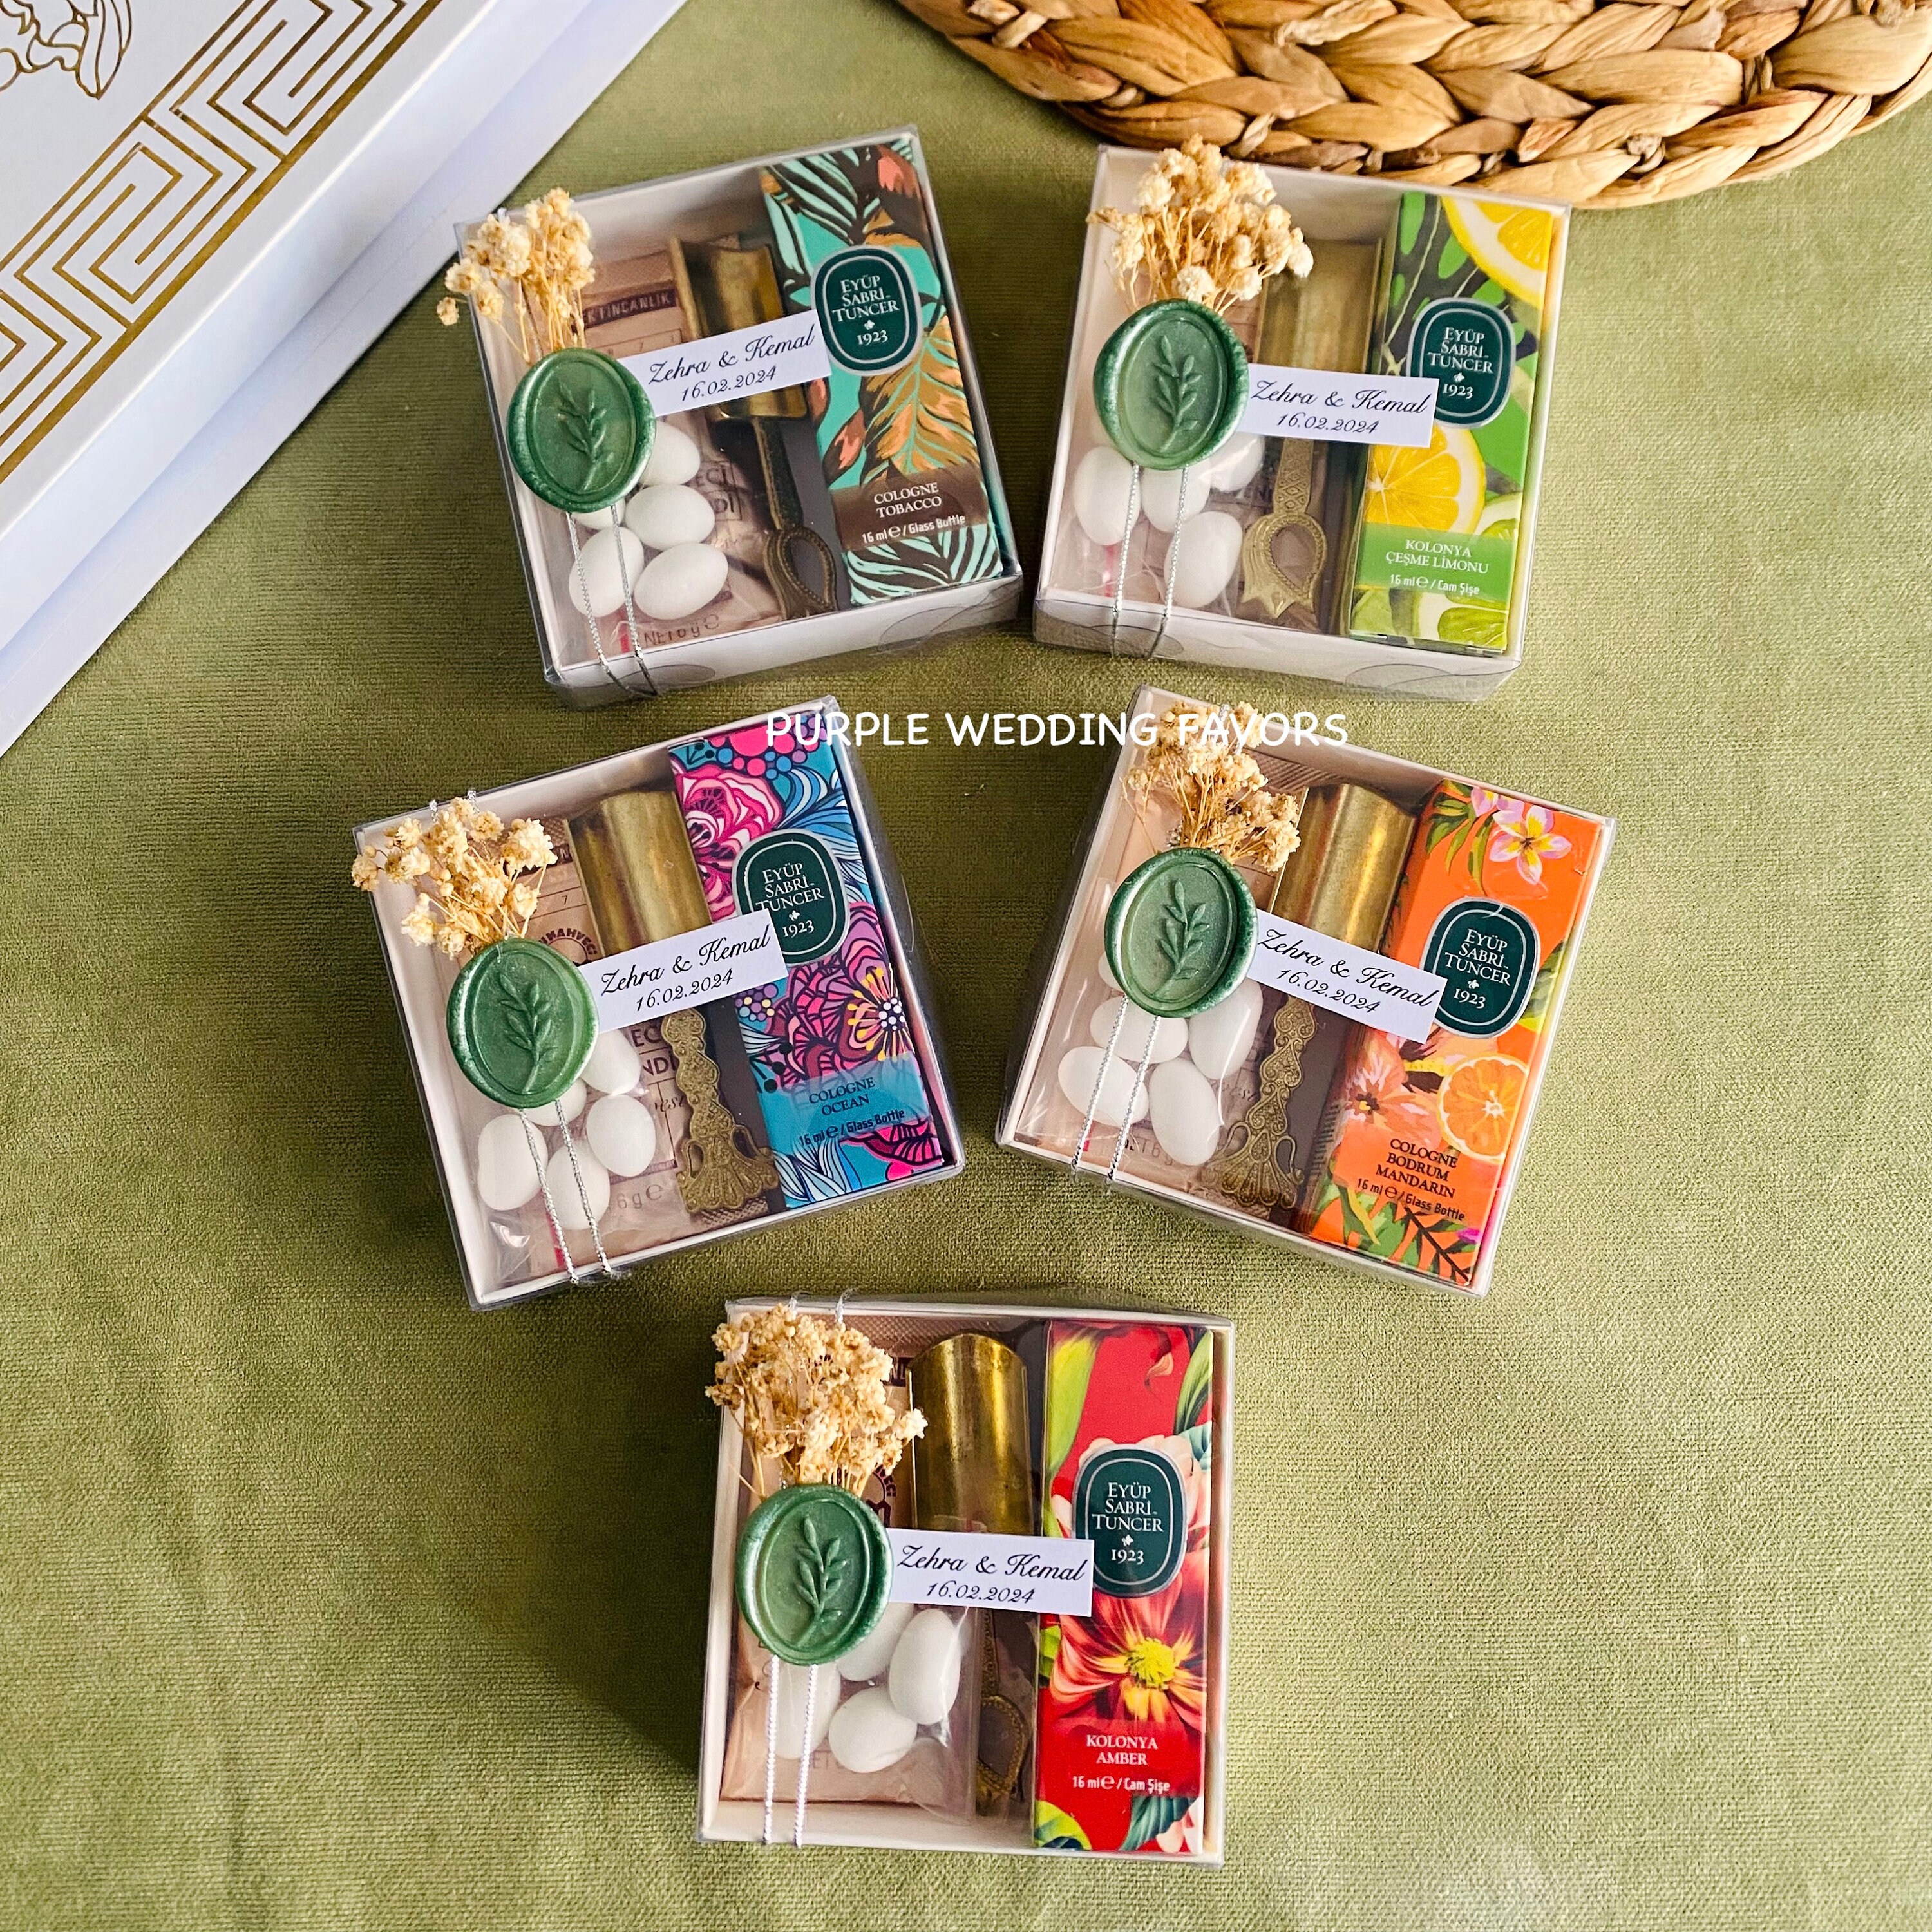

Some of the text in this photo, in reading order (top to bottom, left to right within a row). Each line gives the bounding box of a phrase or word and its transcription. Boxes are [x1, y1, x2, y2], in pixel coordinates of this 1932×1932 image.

[840, 274, 880, 293] EYÜP
[831, 299, 900, 322] TUNCER
[857, 330, 888, 345] 1923
[1444, 327, 1484, 344] EYÜP
[648, 323, 815, 385] Zehra & Kemal
[1428, 352, 1493, 374] TUNCER
[681, 365, 777, 401] 16.02.2024
[1443, 383, 1473, 399] 1923
[1251, 380, 1432, 413] Zehra & Kemal
[1277, 412, 1379, 434] 16.02.2024
[874, 482, 939, 504] COLOGNE
[876, 496, 942, 518] TOBACCO
[862, 532, 875, 544] 16
[908, 521, 934, 534] Glass
[936, 515, 966, 529] Bottle
[1406, 539, 1472, 558] KOLONYA
[1386, 551, 1489, 574] ÇEŞME LİMONU
[1390, 574, 1401, 585] 16
[1437, 580, 1457, 592] Cam
[1459, 582, 1480, 596] Şişe
[762, 862, 803, 884] EYÜP
[755, 887, 825, 911] TUNCER
[782, 920, 815, 938] 1923
[1464, 929, 1508, 952] EYÜP
[601, 924, 771, 996] Zehra & Kemal
[1258, 929, 1439, 1007] Zehra & Kemal
[1445, 952, 1511, 986] TUNCER
[636, 968, 733, 1012] 16.02.2024
[1277, 969, 1381, 1013] 16.02.2024
[1454, 988, 1486, 1009] 1923
[809, 1077, 875, 1104] COLOGNE
[822, 1094, 869, 1116] OCEAN
[799, 1135, 811, 1146] 16
[846, 1119, 873, 1132] Glass
[875, 1109, 905, 1125] Bottle
[1390, 1139, 1459, 1168] COLOGNE
[1387, 1152, 1450, 1182] BODRUM
[1376, 1164, 1455, 1199] MANDARIN
[1358, 1178, 1368, 1189] 16
[1406, 1193, 1432, 1211] Glass
[1434, 1202, 1464, 1221] Bottle
[1108, 1481, 1151, 1499] EYÜP
[1092, 1514, 1164, 1533] TUNCER
[897, 1544, 1088, 1582] Zehra & Kemal
[1112, 1549, 1144, 1565] 1923
[927, 1580, 1036, 1604] 16.02.2024
[1086, 1734, 1159, 1750] KOLONYA
[1096, 1752, 1148, 1765] AMBER
[1072, 1776, 1084, 1788] 16
[1124, 1777, 1145, 1790] Cam
[1148, 1778, 1170, 1794] Şişe
